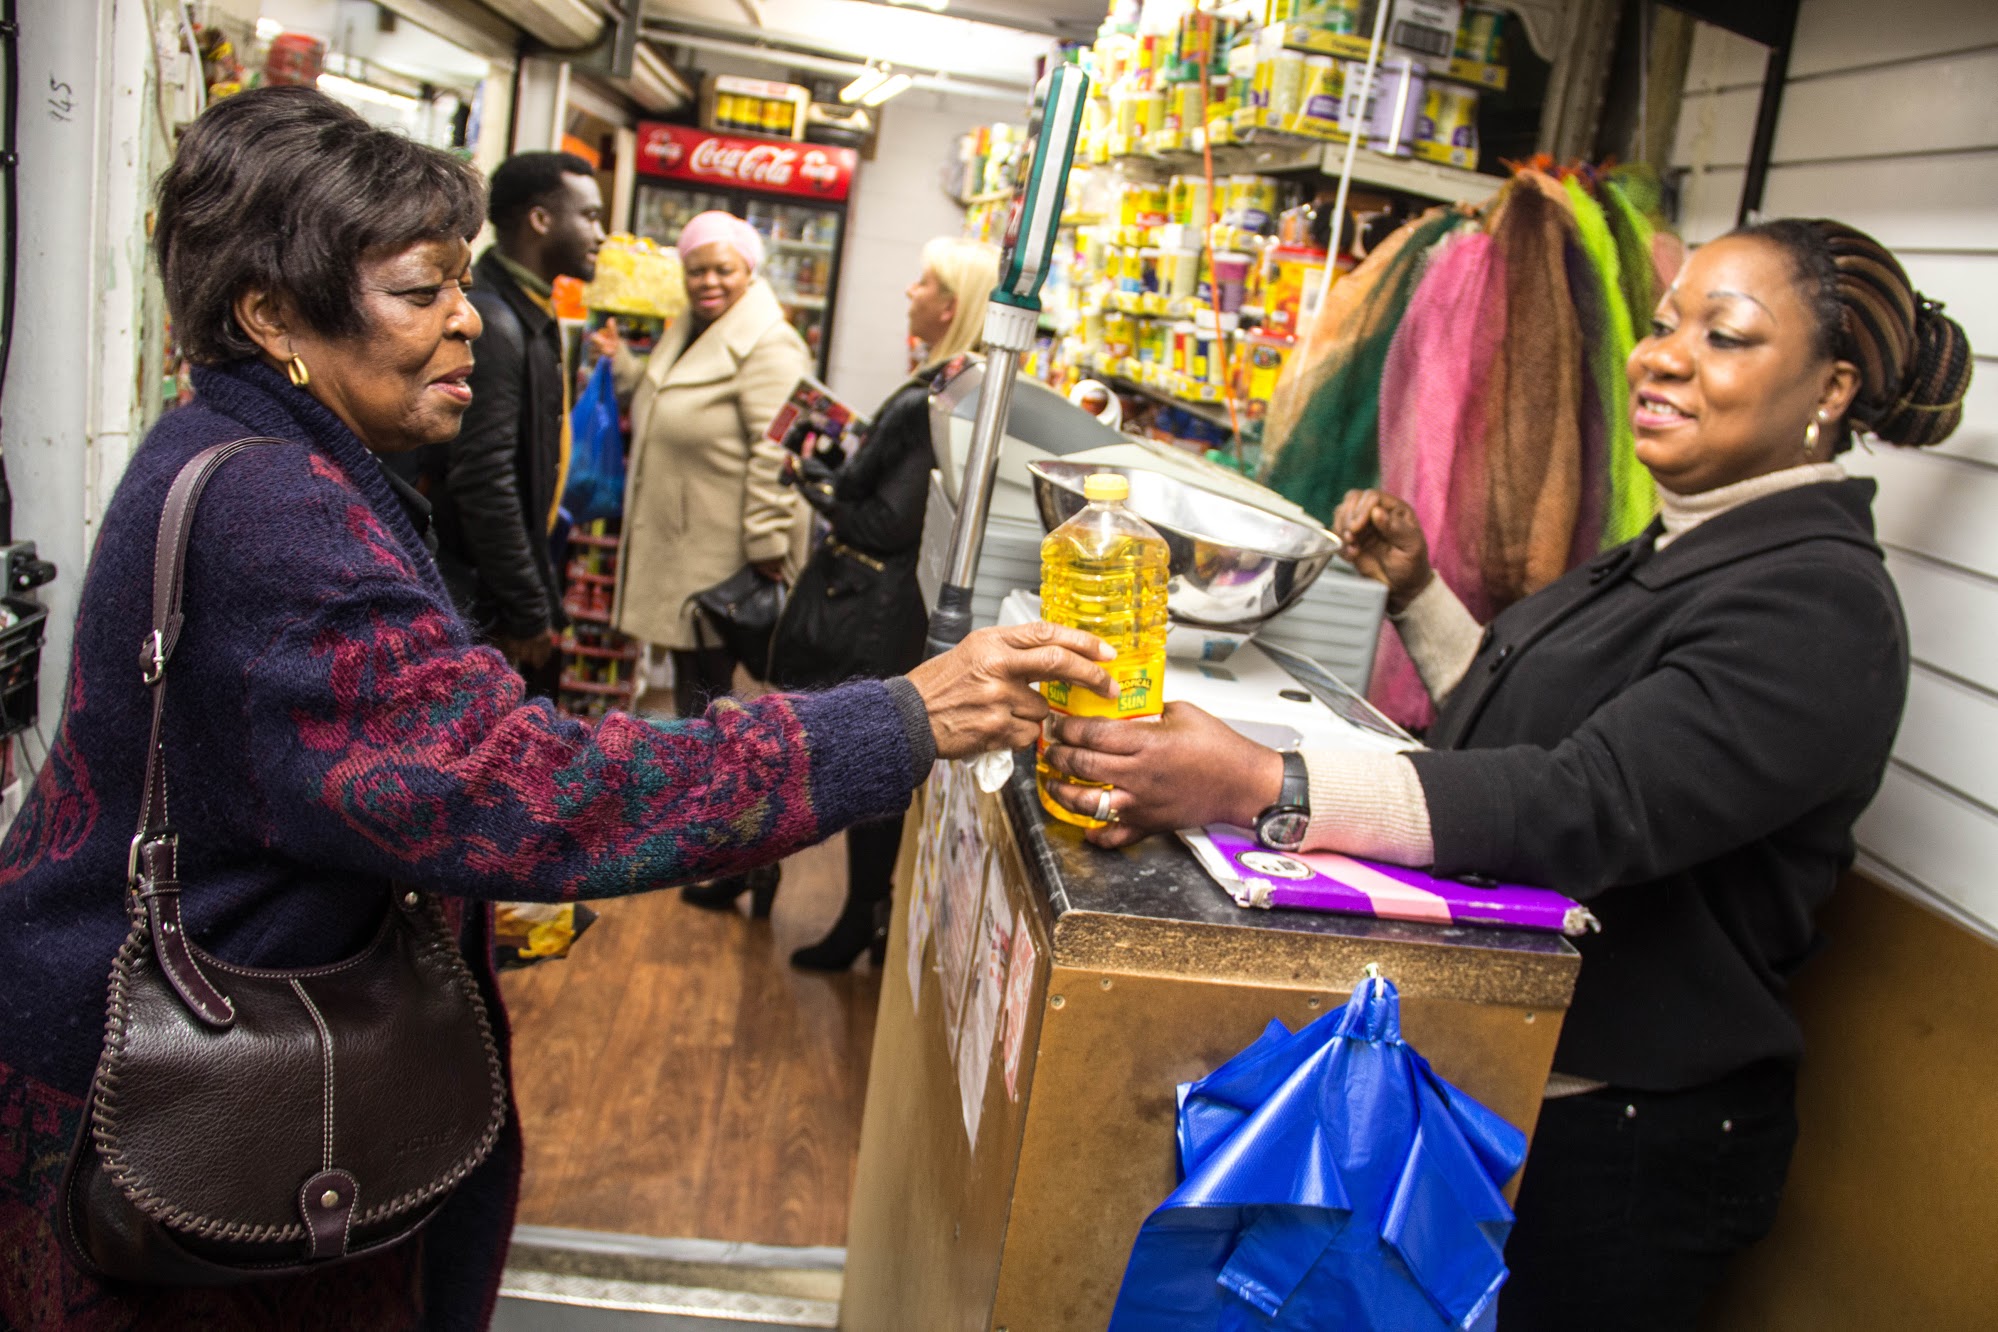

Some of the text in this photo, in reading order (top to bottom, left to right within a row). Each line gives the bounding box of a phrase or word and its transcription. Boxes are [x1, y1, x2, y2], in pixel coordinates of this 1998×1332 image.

[690, 138, 797, 184] Coca-Cola
[1119, 678, 1152, 691] ROPICAL
[1049, 685, 1067, 704] SUN
[1120, 695, 1146, 710] SUN
